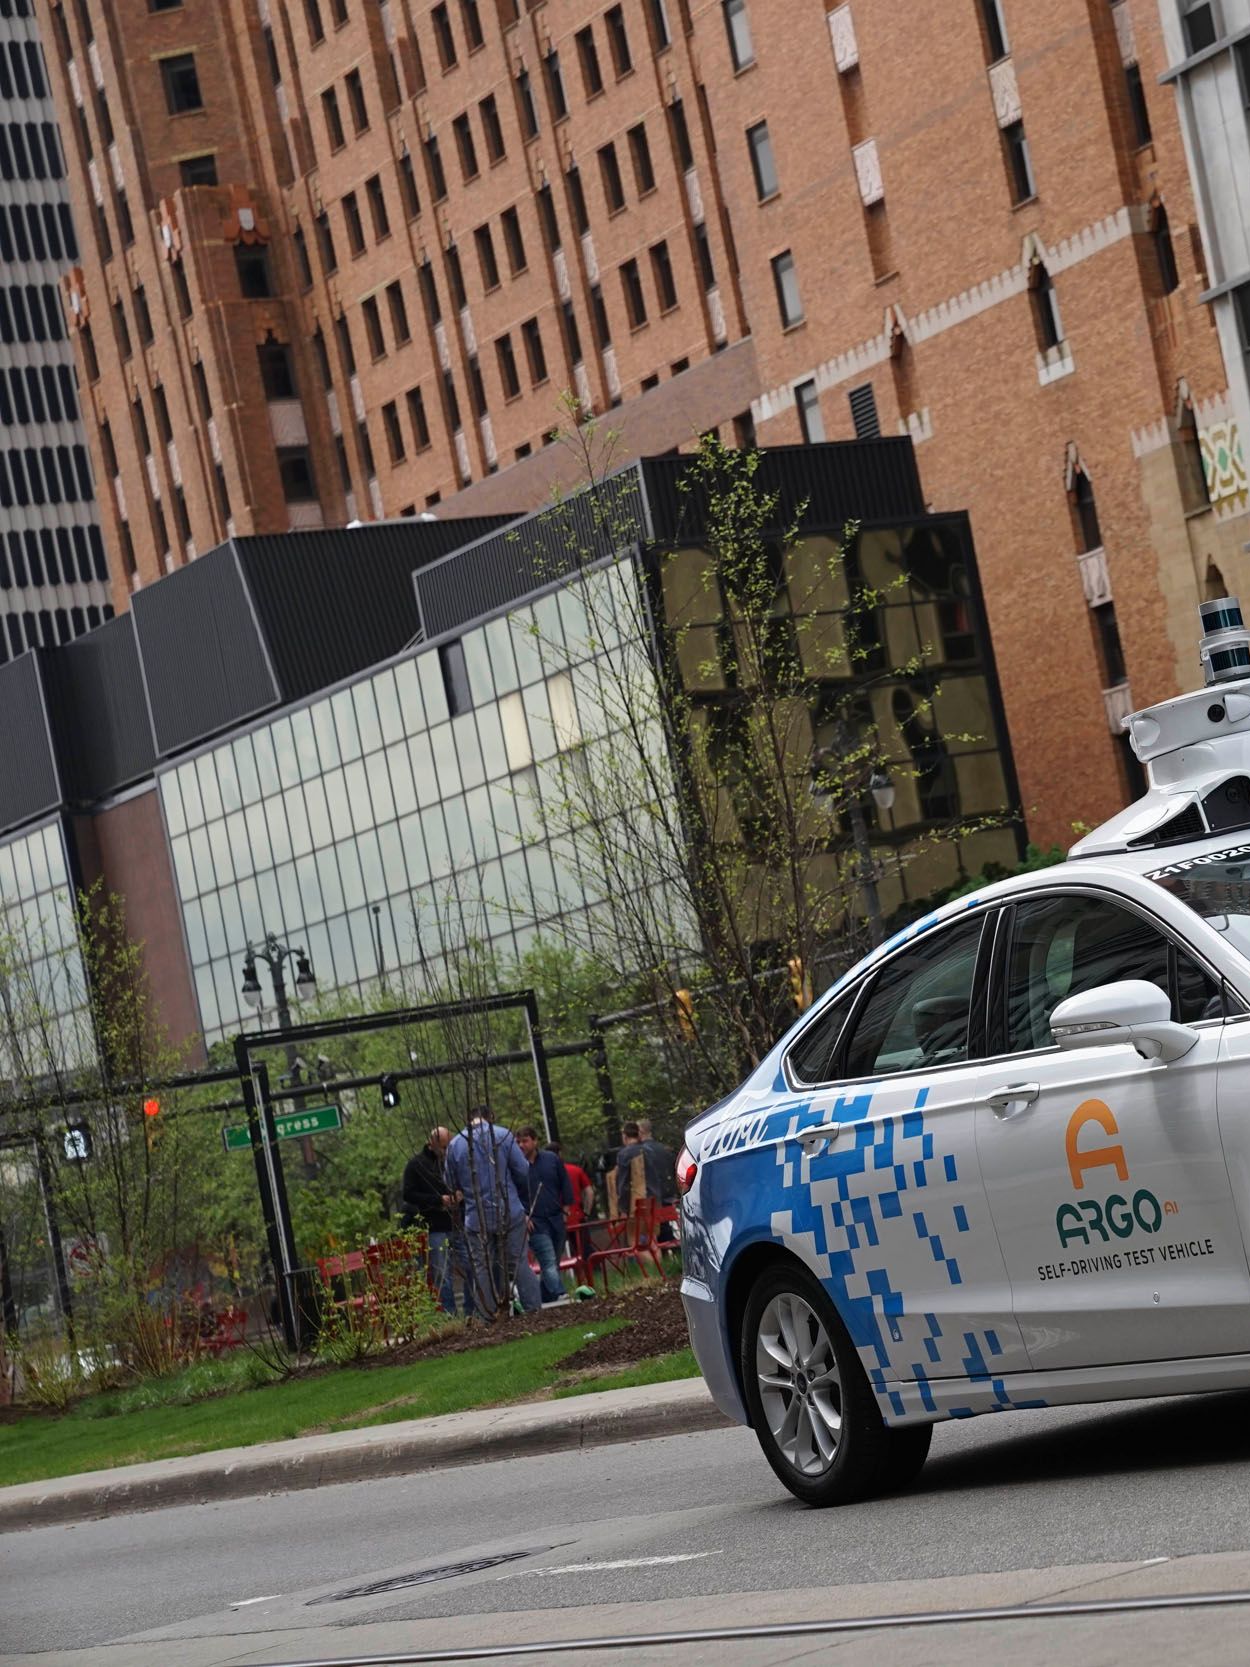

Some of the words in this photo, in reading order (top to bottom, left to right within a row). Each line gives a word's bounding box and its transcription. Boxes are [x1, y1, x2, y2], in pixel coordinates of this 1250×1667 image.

[1056, 1189, 1162, 1249] ARGO
[1164, 1201, 1179, 1216] AI
[1037, 1253, 1123, 1281] SELF-DRIVING
[1123, 1247, 1155, 1267] TEST
[1158, 1238, 1215, 1262] VEHICLE
